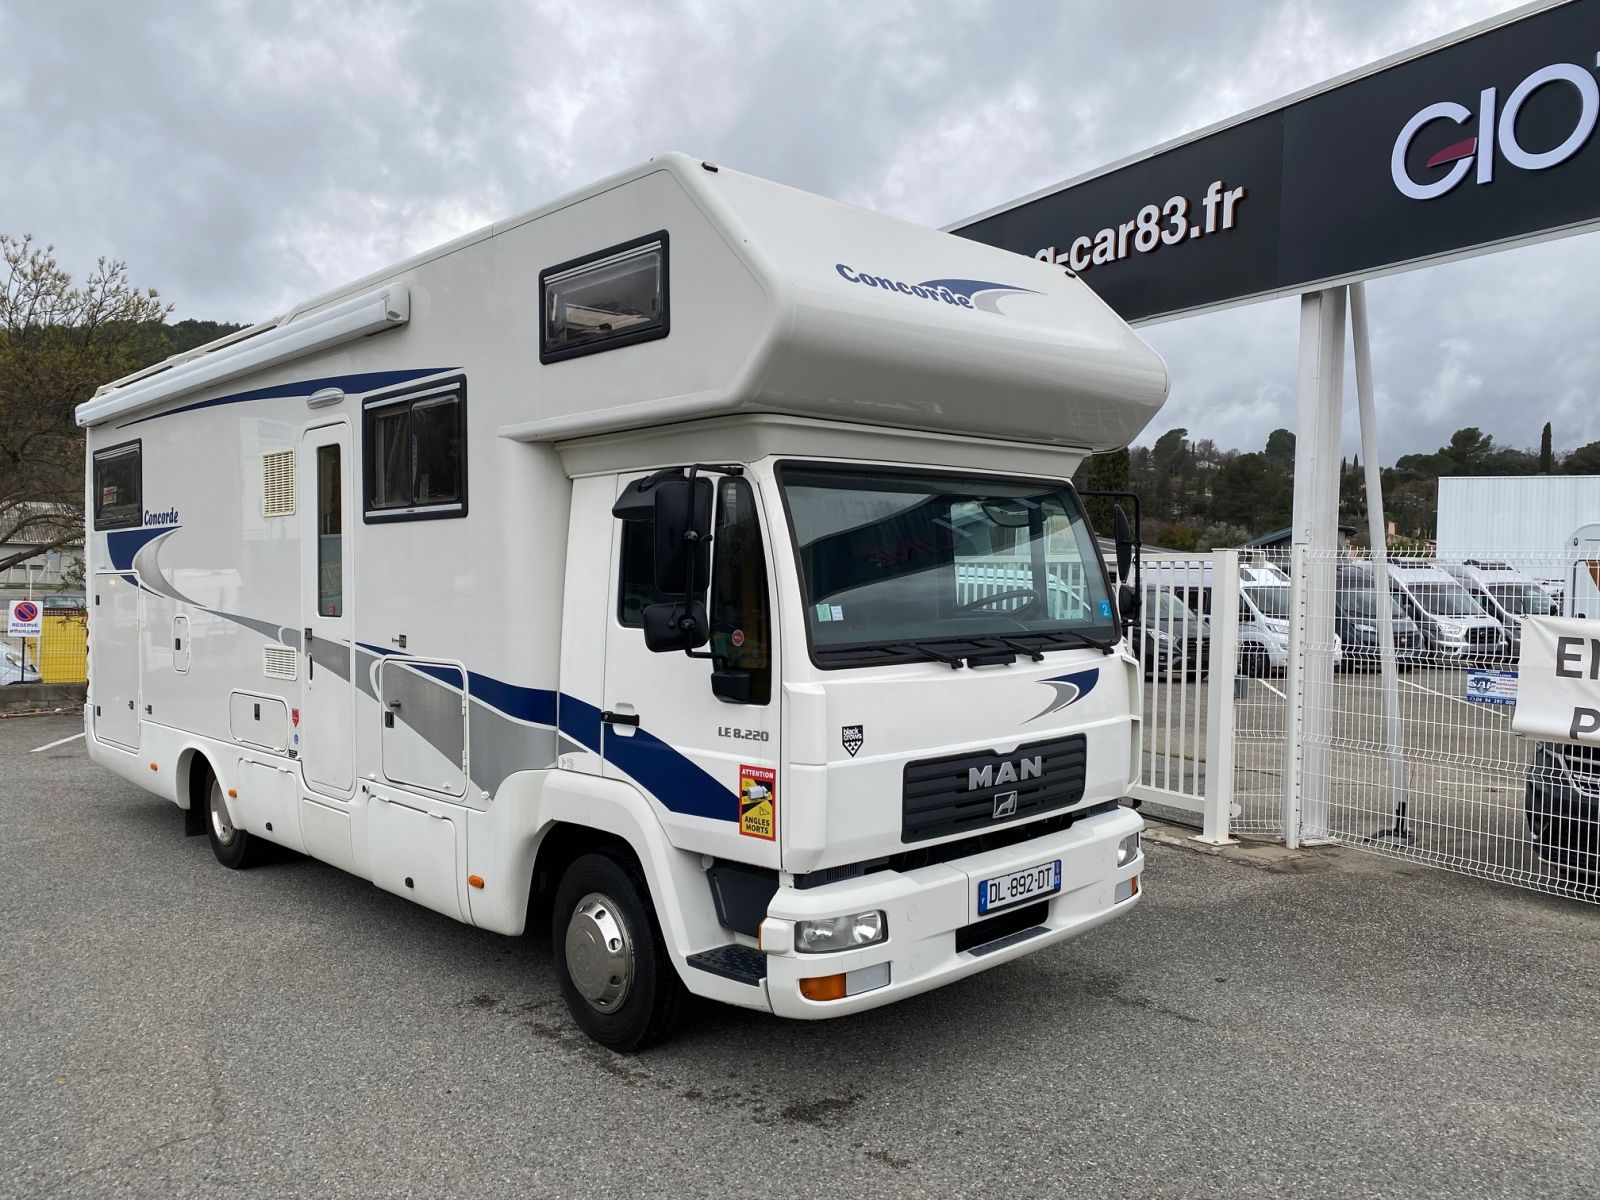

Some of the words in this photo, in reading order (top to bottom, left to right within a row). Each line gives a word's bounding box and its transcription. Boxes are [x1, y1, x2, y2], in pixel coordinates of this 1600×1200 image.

[1391, 51, 1600, 200] GIO
[835, 263, 974, 309] Concorde
[144, 507, 179, 526] Concorde
[1102, 604, 1109, 616] 2
[718, 727, 731, 737] LE
[733, 728, 769, 741] 8.220
[742, 768, 774, 779] ATTENTION
[968, 756, 1042, 790] MAN
[744, 815, 770, 827] ANGLES
[745, 822, 769, 835] MORTS
